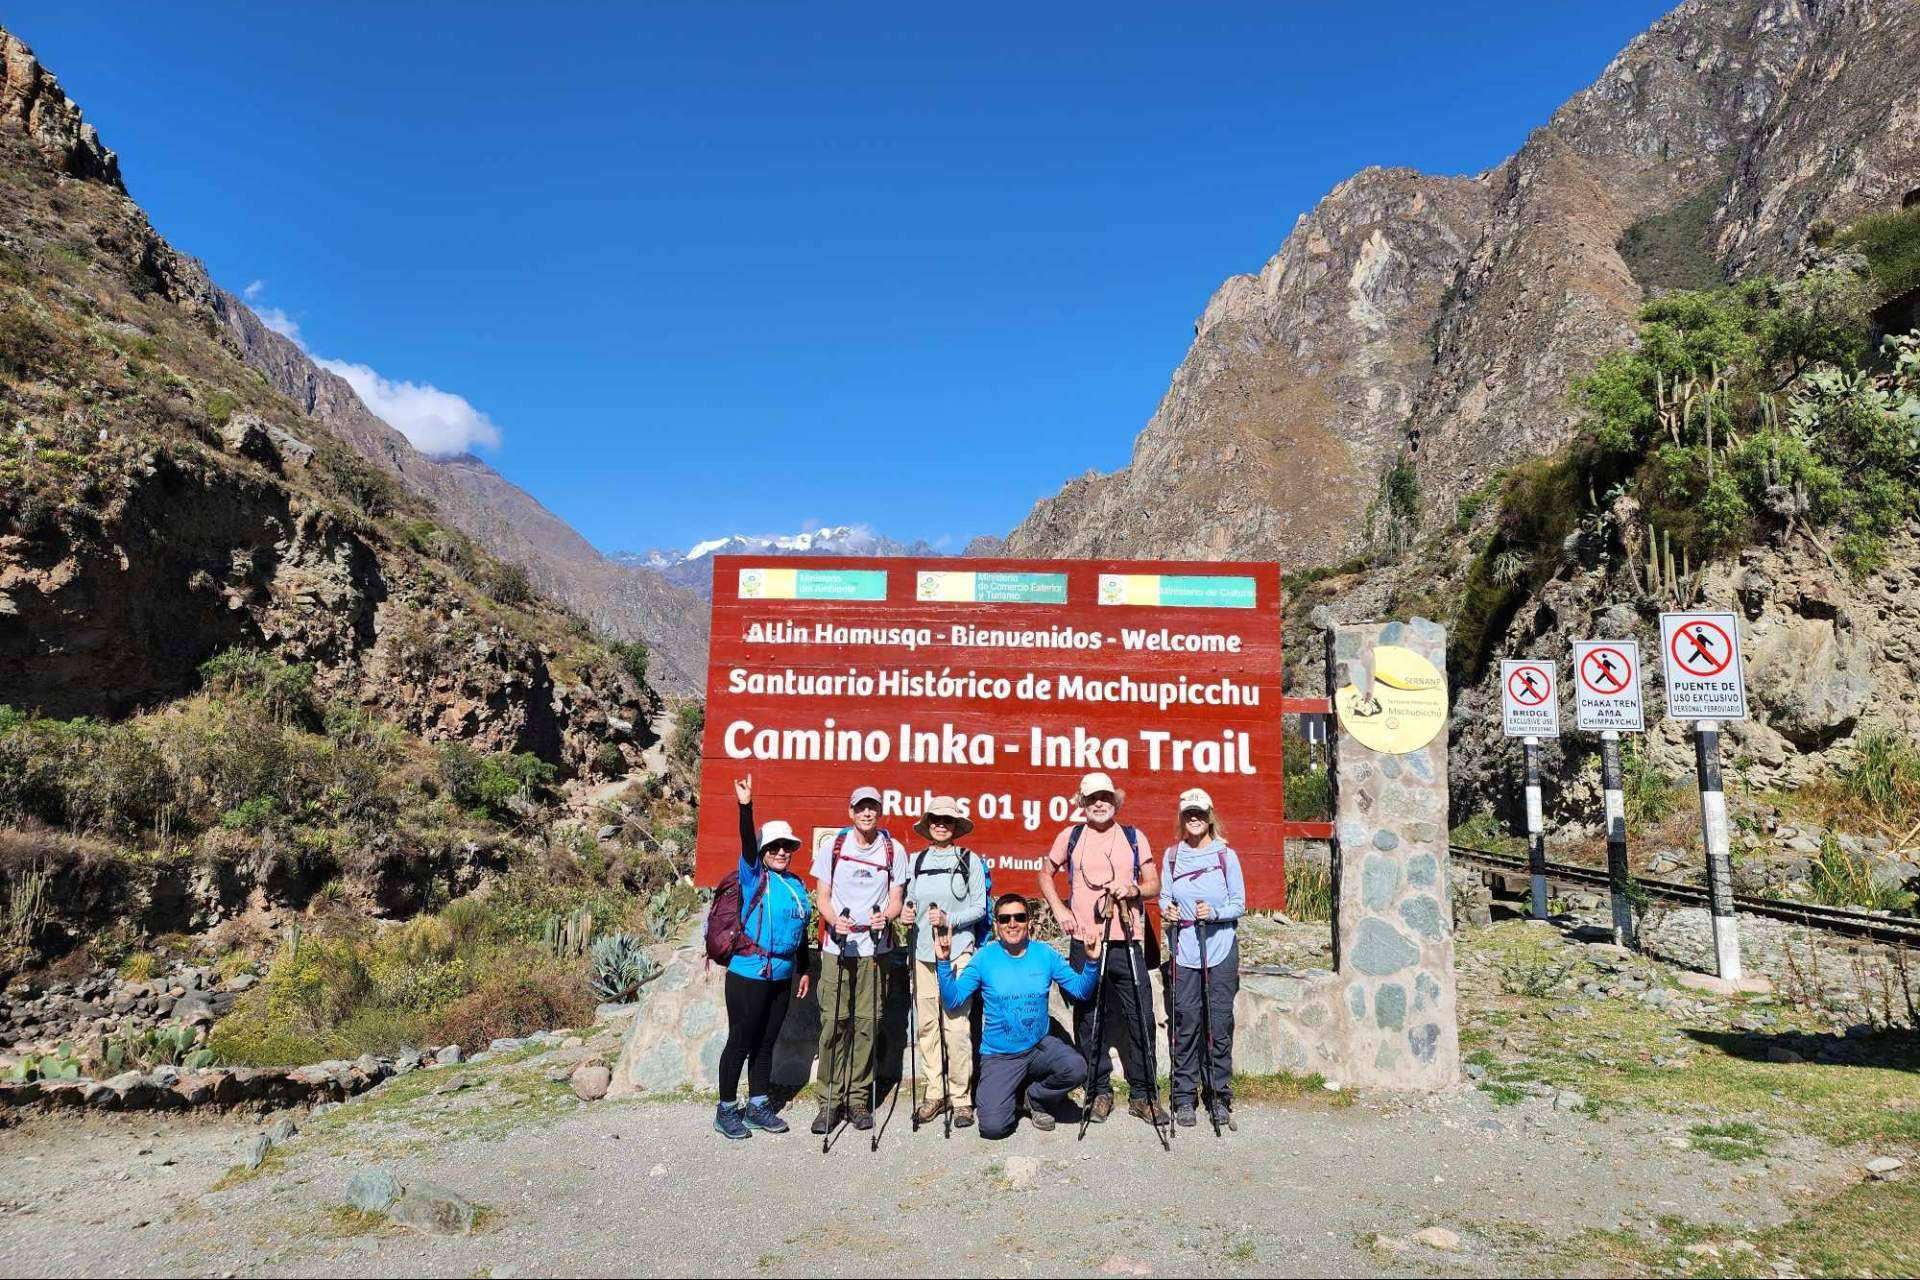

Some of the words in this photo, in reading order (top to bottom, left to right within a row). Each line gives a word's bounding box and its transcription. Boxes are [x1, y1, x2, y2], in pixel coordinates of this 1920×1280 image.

[991, 583, 1029, 592] Comercio
[1031, 584, 1062, 593] Exterior
[743, 620, 808, 644] Allin
[815, 624, 931, 651] Hamusqa
[951, 624, 1102, 650] Bienvenidos
[1120, 629, 1243, 652] Welcome
[728, 668, 874, 696] Santuario
[878, 667, 1010, 699] Histórico
[1016, 672, 1052, 701] de
[1057, 675, 1260, 710] Machupicchu
[1674, 682, 1718, 691] PUENTE
[1721, 682, 1736, 691] DE
[1674, 693, 1691, 702] USO
[1692, 694, 1739, 702] EXCLUSIVO
[1581, 699, 1611, 707] CHAKA
[1613, 699, 1637, 707] TREN
[1512, 710, 1549, 718] BRIDGE
[1597, 709, 1621, 717] AMA
[725, 719, 891, 762] Camino
[899, 723, 995, 764] Inka
[1030, 726, 1129, 769] Inka
[1139, 729, 1257, 774] Trail
[882, 789, 970, 819] Ruts
[978, 793, 1015, 820] 01
[1022, 799, 1041, 831] y
